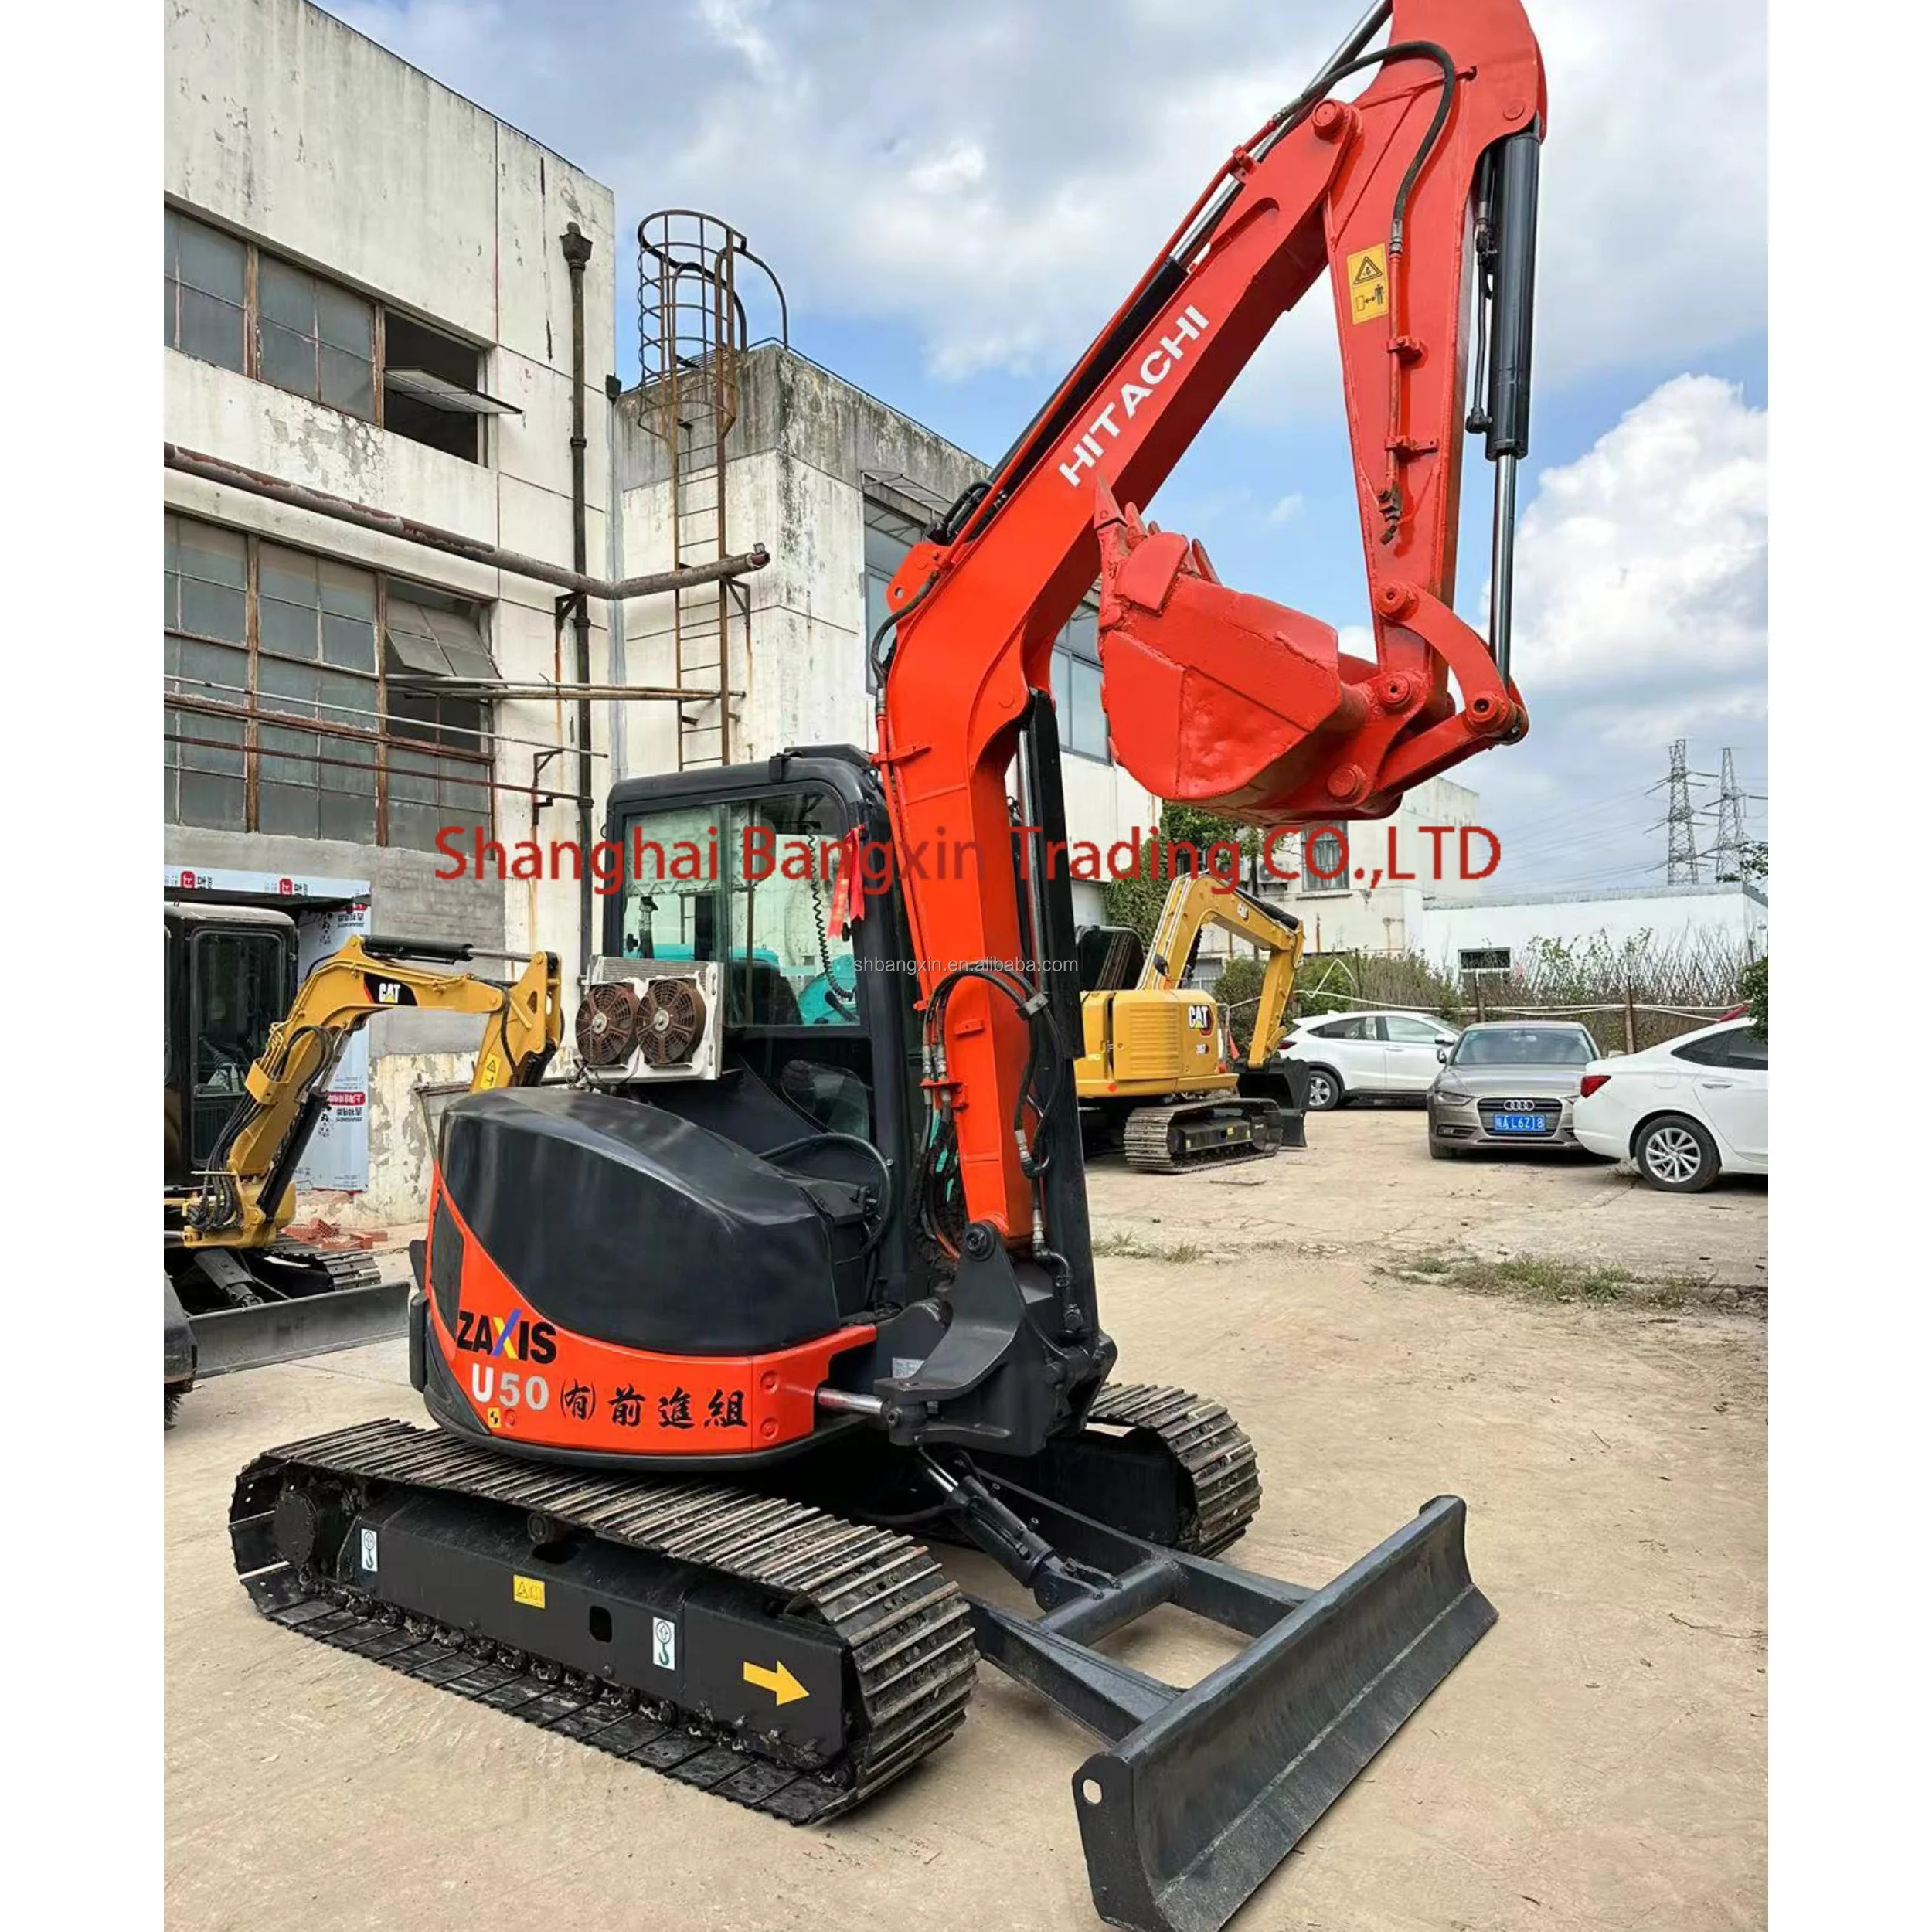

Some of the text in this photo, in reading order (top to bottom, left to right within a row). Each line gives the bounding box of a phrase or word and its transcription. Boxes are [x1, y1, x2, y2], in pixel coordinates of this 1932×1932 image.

[1058, 304, 1209, 487] HITACHI
[379, 982, 401, 1003] CAT
[1189, 1005, 1209, 1029] CAT
[457, 1309, 556, 1364] ZAXIS
[471, 1363, 549, 1410] U50
